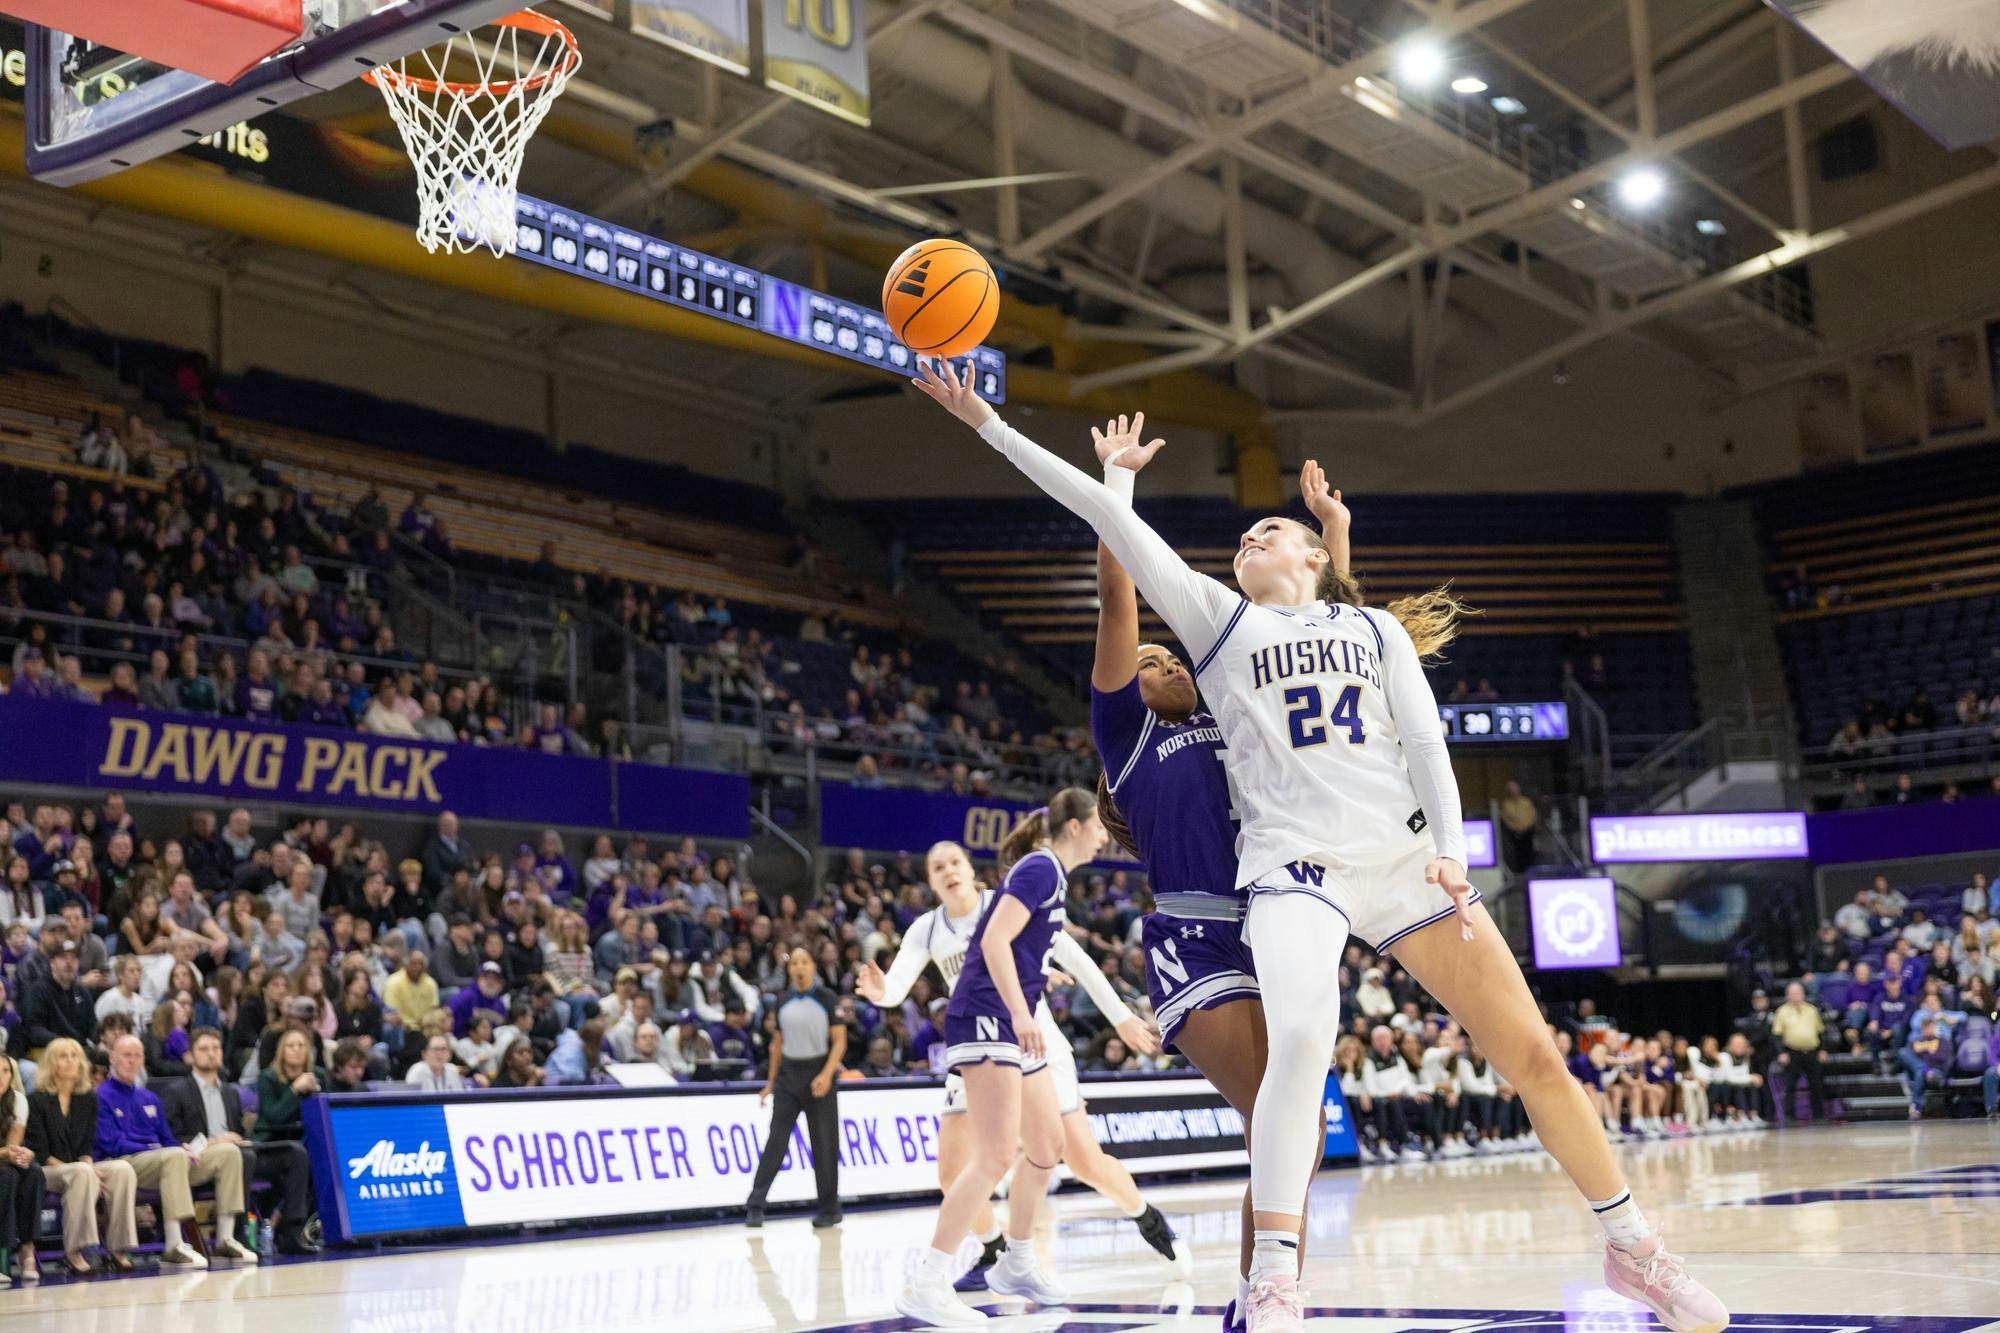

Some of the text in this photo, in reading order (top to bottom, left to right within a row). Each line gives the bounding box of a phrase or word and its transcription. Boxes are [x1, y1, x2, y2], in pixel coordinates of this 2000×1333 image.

[1250, 638, 1381, 691] HUSKIES
[1282, 682, 1367, 752] 24
[99, 717, 448, 803] DAWG PACK
[963, 806, 1011, 851] GO
[1595, 820, 1800, 859] planet fitness
[1285, 860, 1326, 888] W
[1150, 937, 1190, 997] N
[976, 1015, 1000, 1041] N
[348, 1139, 447, 1179] Alaska
[464, 1125, 695, 1193] SCHROETER
[359, 1179, 444, 1200] AIRLINES
